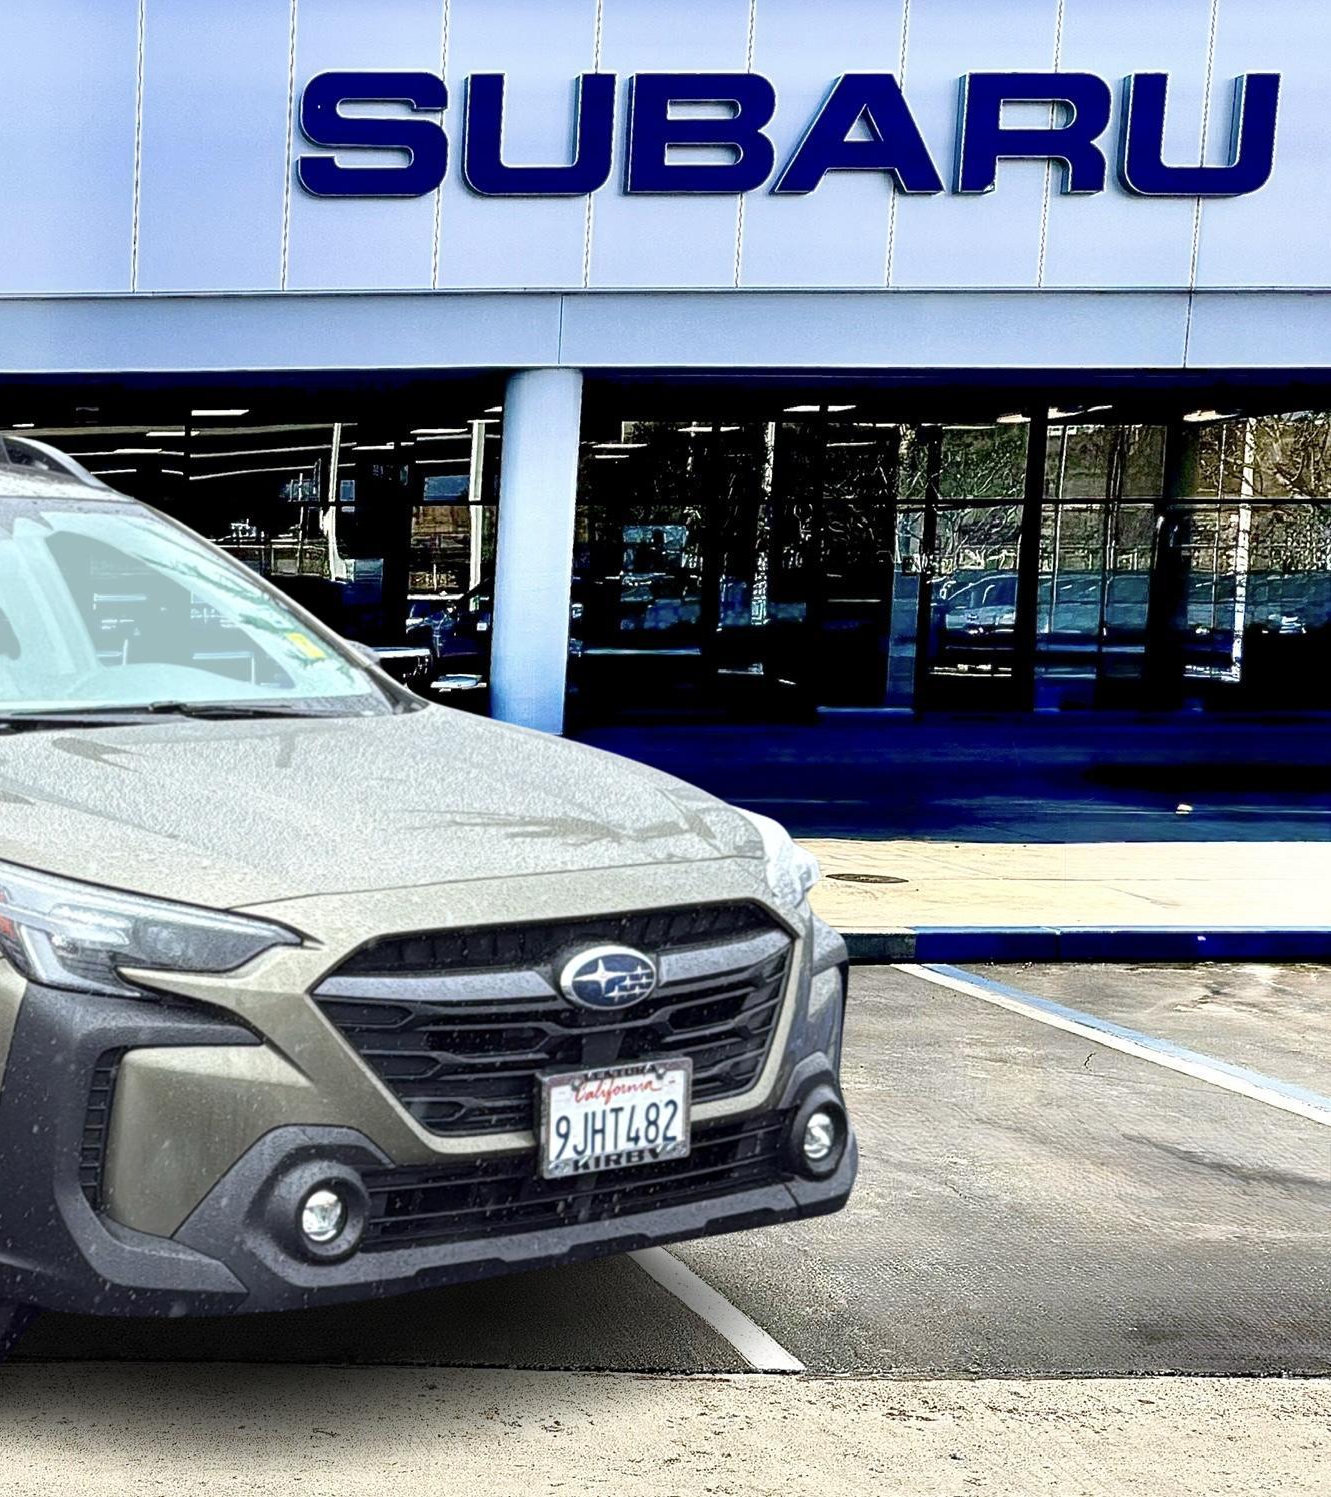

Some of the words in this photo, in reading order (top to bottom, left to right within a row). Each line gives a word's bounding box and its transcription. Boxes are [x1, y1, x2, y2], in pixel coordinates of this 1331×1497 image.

[296, 71, 1282, 199] SUBARU
[575, 1079, 662, 1105] California
[584, 1063, 657, 1082] VENTURA
[555, 1099, 679, 1160] 9JHT482
